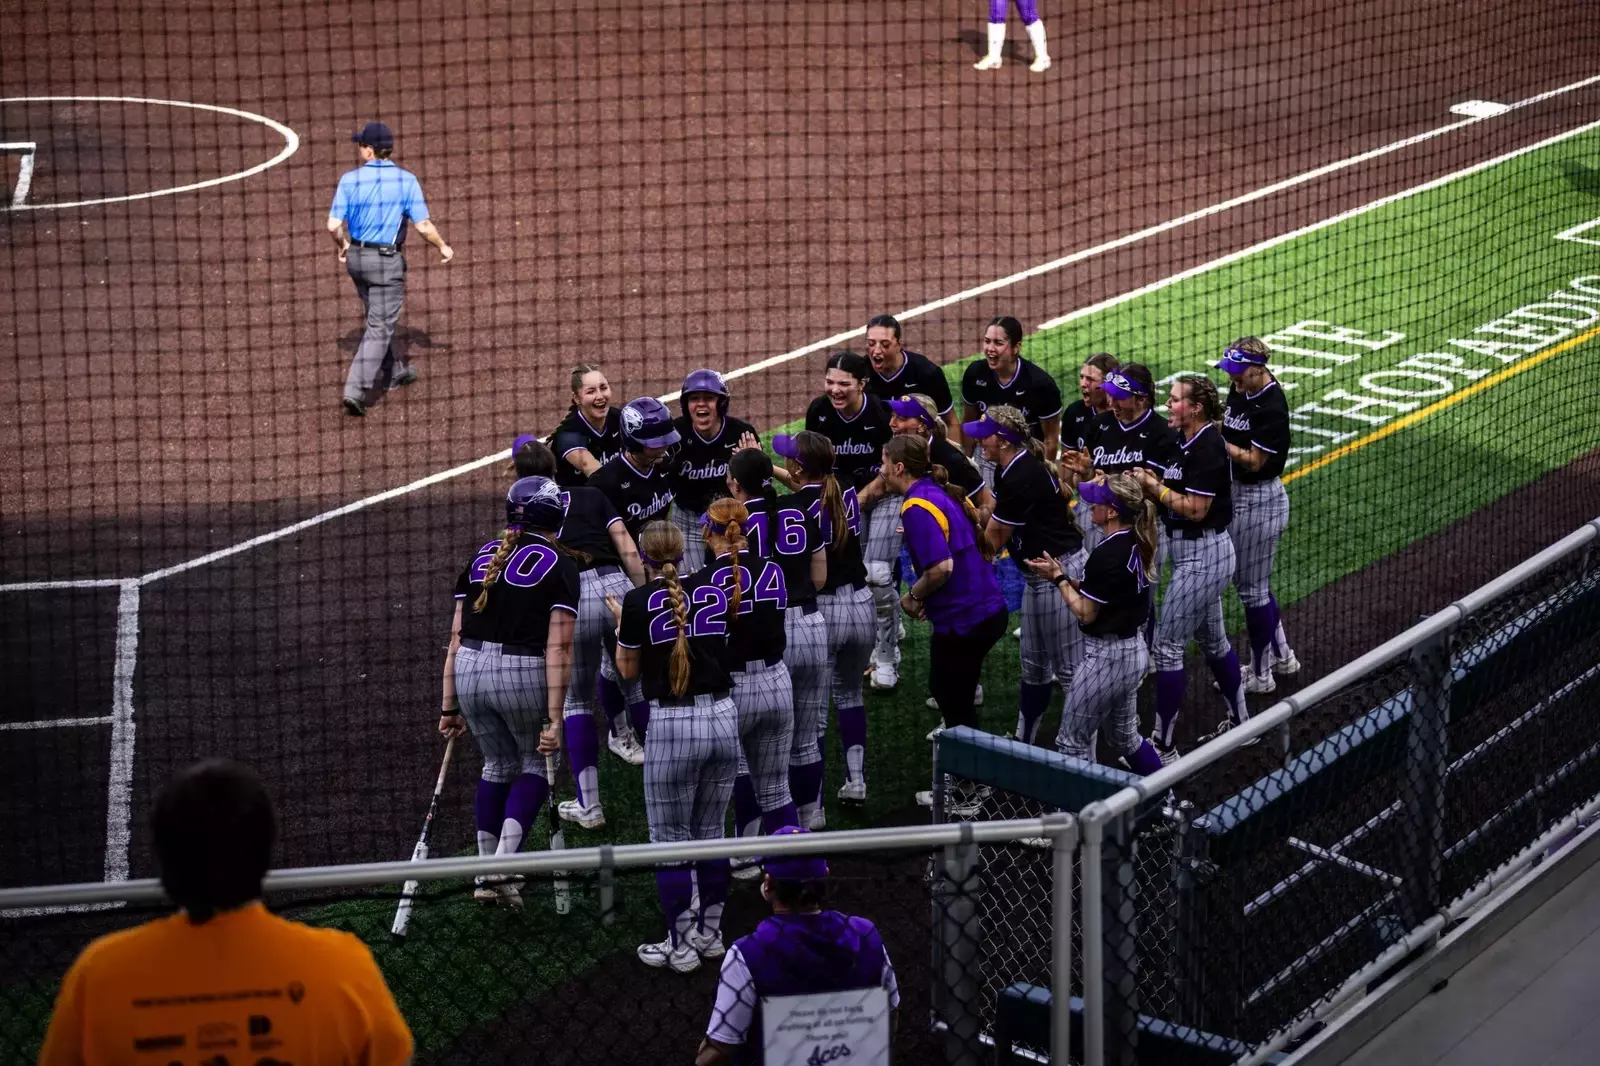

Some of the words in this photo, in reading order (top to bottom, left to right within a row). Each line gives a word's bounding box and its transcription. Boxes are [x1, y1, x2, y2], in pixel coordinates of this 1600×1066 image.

[679, 459, 729, 480] Panther
[831, 438, 875, 455] nthers
[1093, 446, 1143, 466] Panthers
[746, 508, 807, 556] 16
[807, 486, 861, 545] 14
[469, 539, 559, 588] 20
[711, 561, 788, 615] 24
[647, 585, 728, 645] 22
